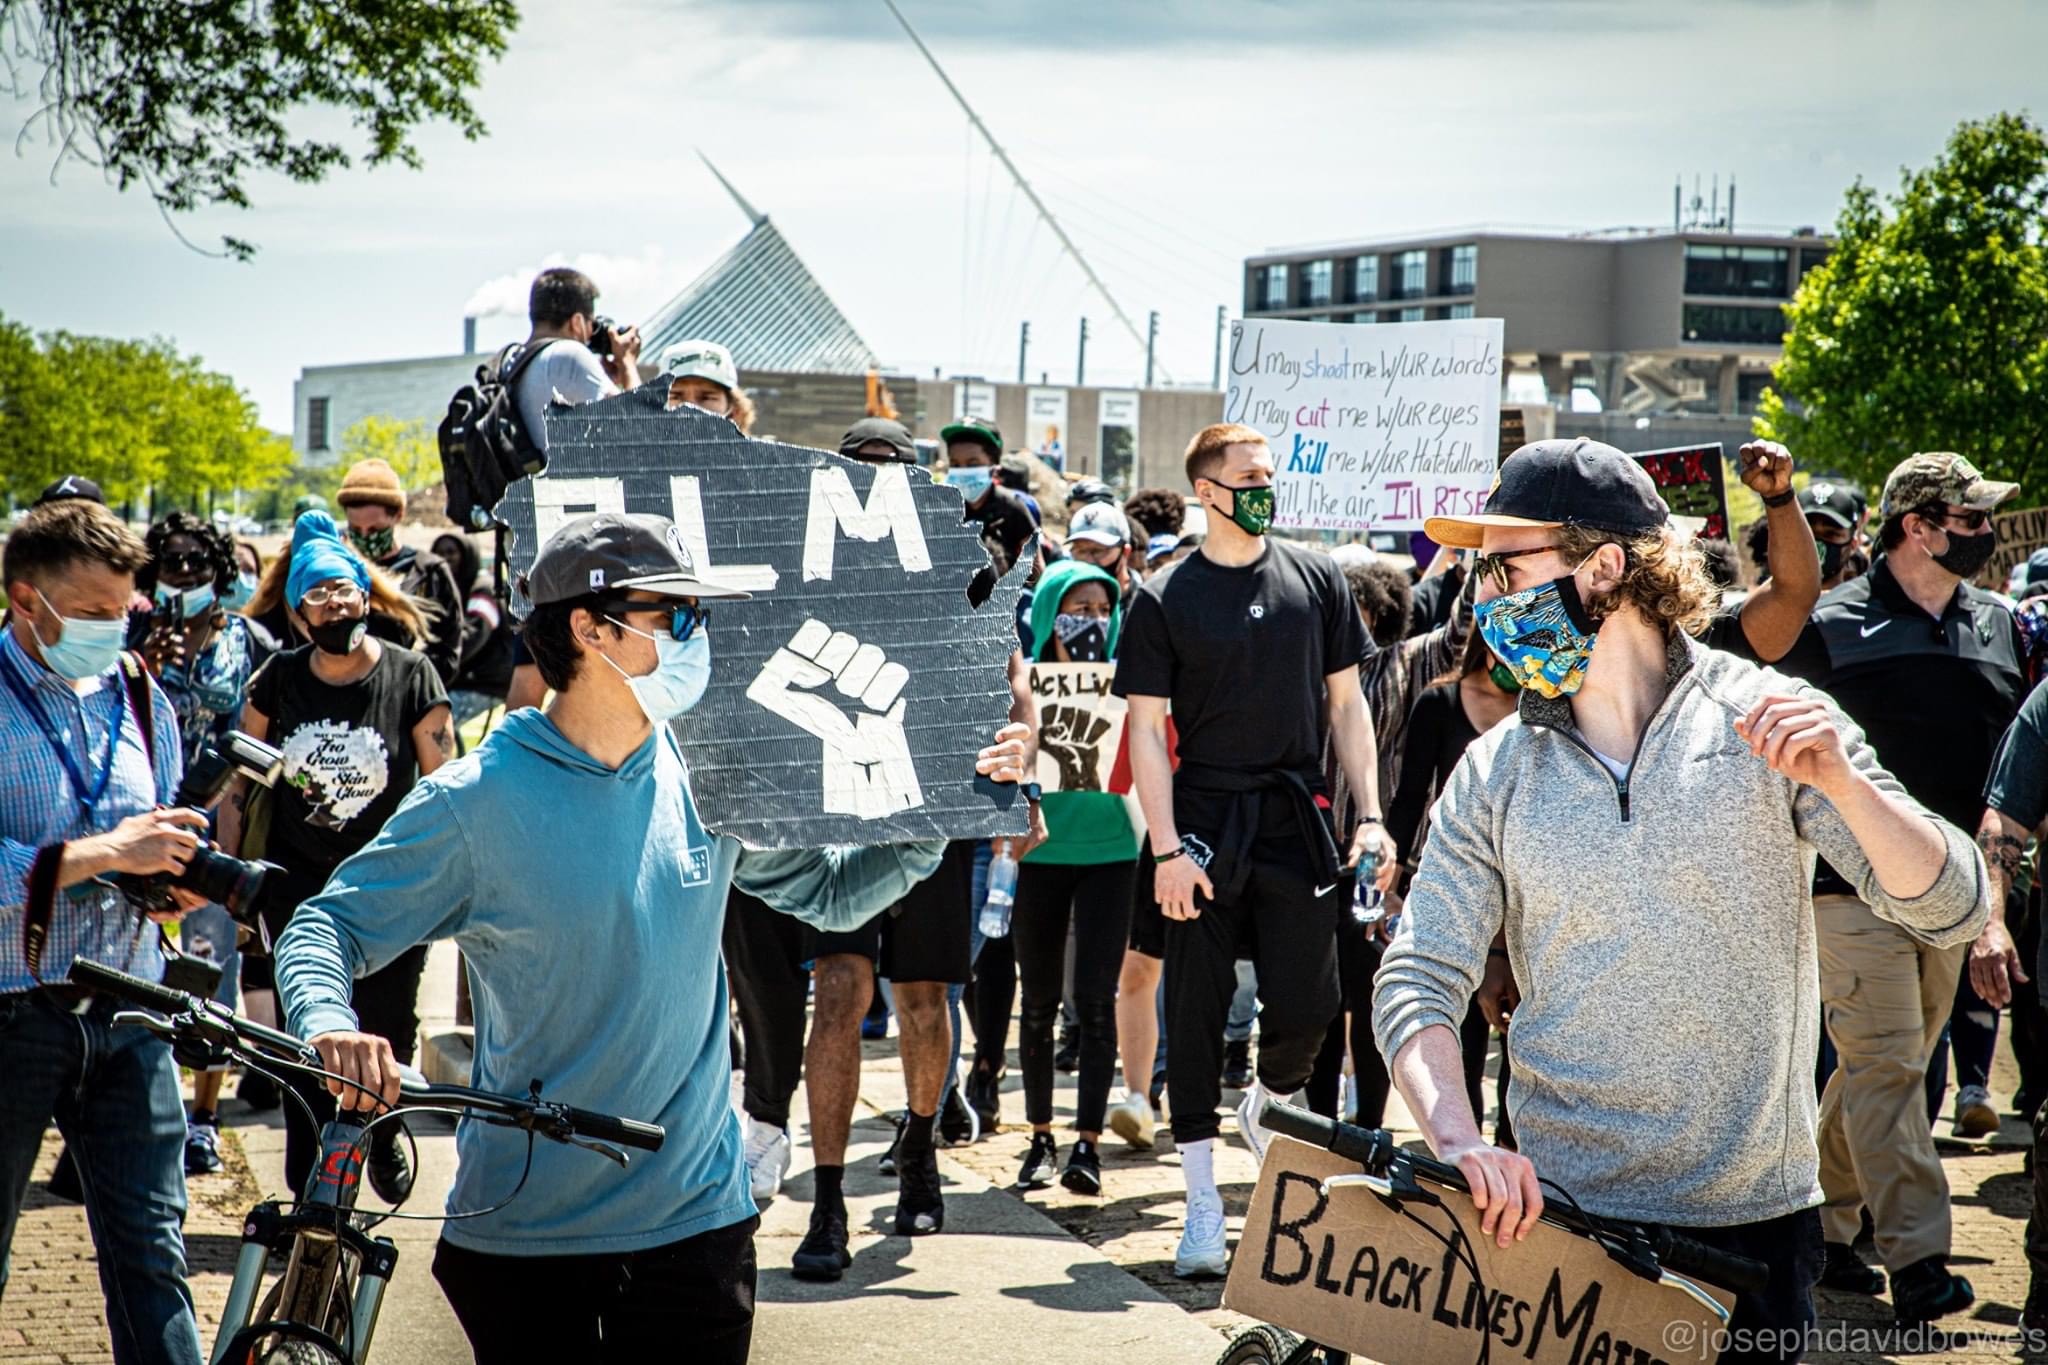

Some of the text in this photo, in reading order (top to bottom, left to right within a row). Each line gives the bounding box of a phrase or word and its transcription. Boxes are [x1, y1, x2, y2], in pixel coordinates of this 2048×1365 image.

[1232, 326, 1264, 375] U
[1302, 347, 1350, 380] shoot
[1353, 360, 1377, 379] me
[1431, 342, 1497, 377] words
[1226, 385, 1253, 424] U
[1295, 397, 1331, 428] cut
[1338, 407, 1368, 428] me
[1428, 402, 1480, 441] eyes
[1328, 451, 1357, 472] me
[1307, 478, 1339, 514] like
[1345, 485, 1378, 522] air,
[1434, 486, 1490, 515] RISE
[306, 751, 349, 766] Grow
[332, 770, 368, 786] Skin
[336, 786, 375, 800] Glow
[1261, 1170, 1433, 1313] BLACK
[1432, 1229, 1532, 1348] LIVES
